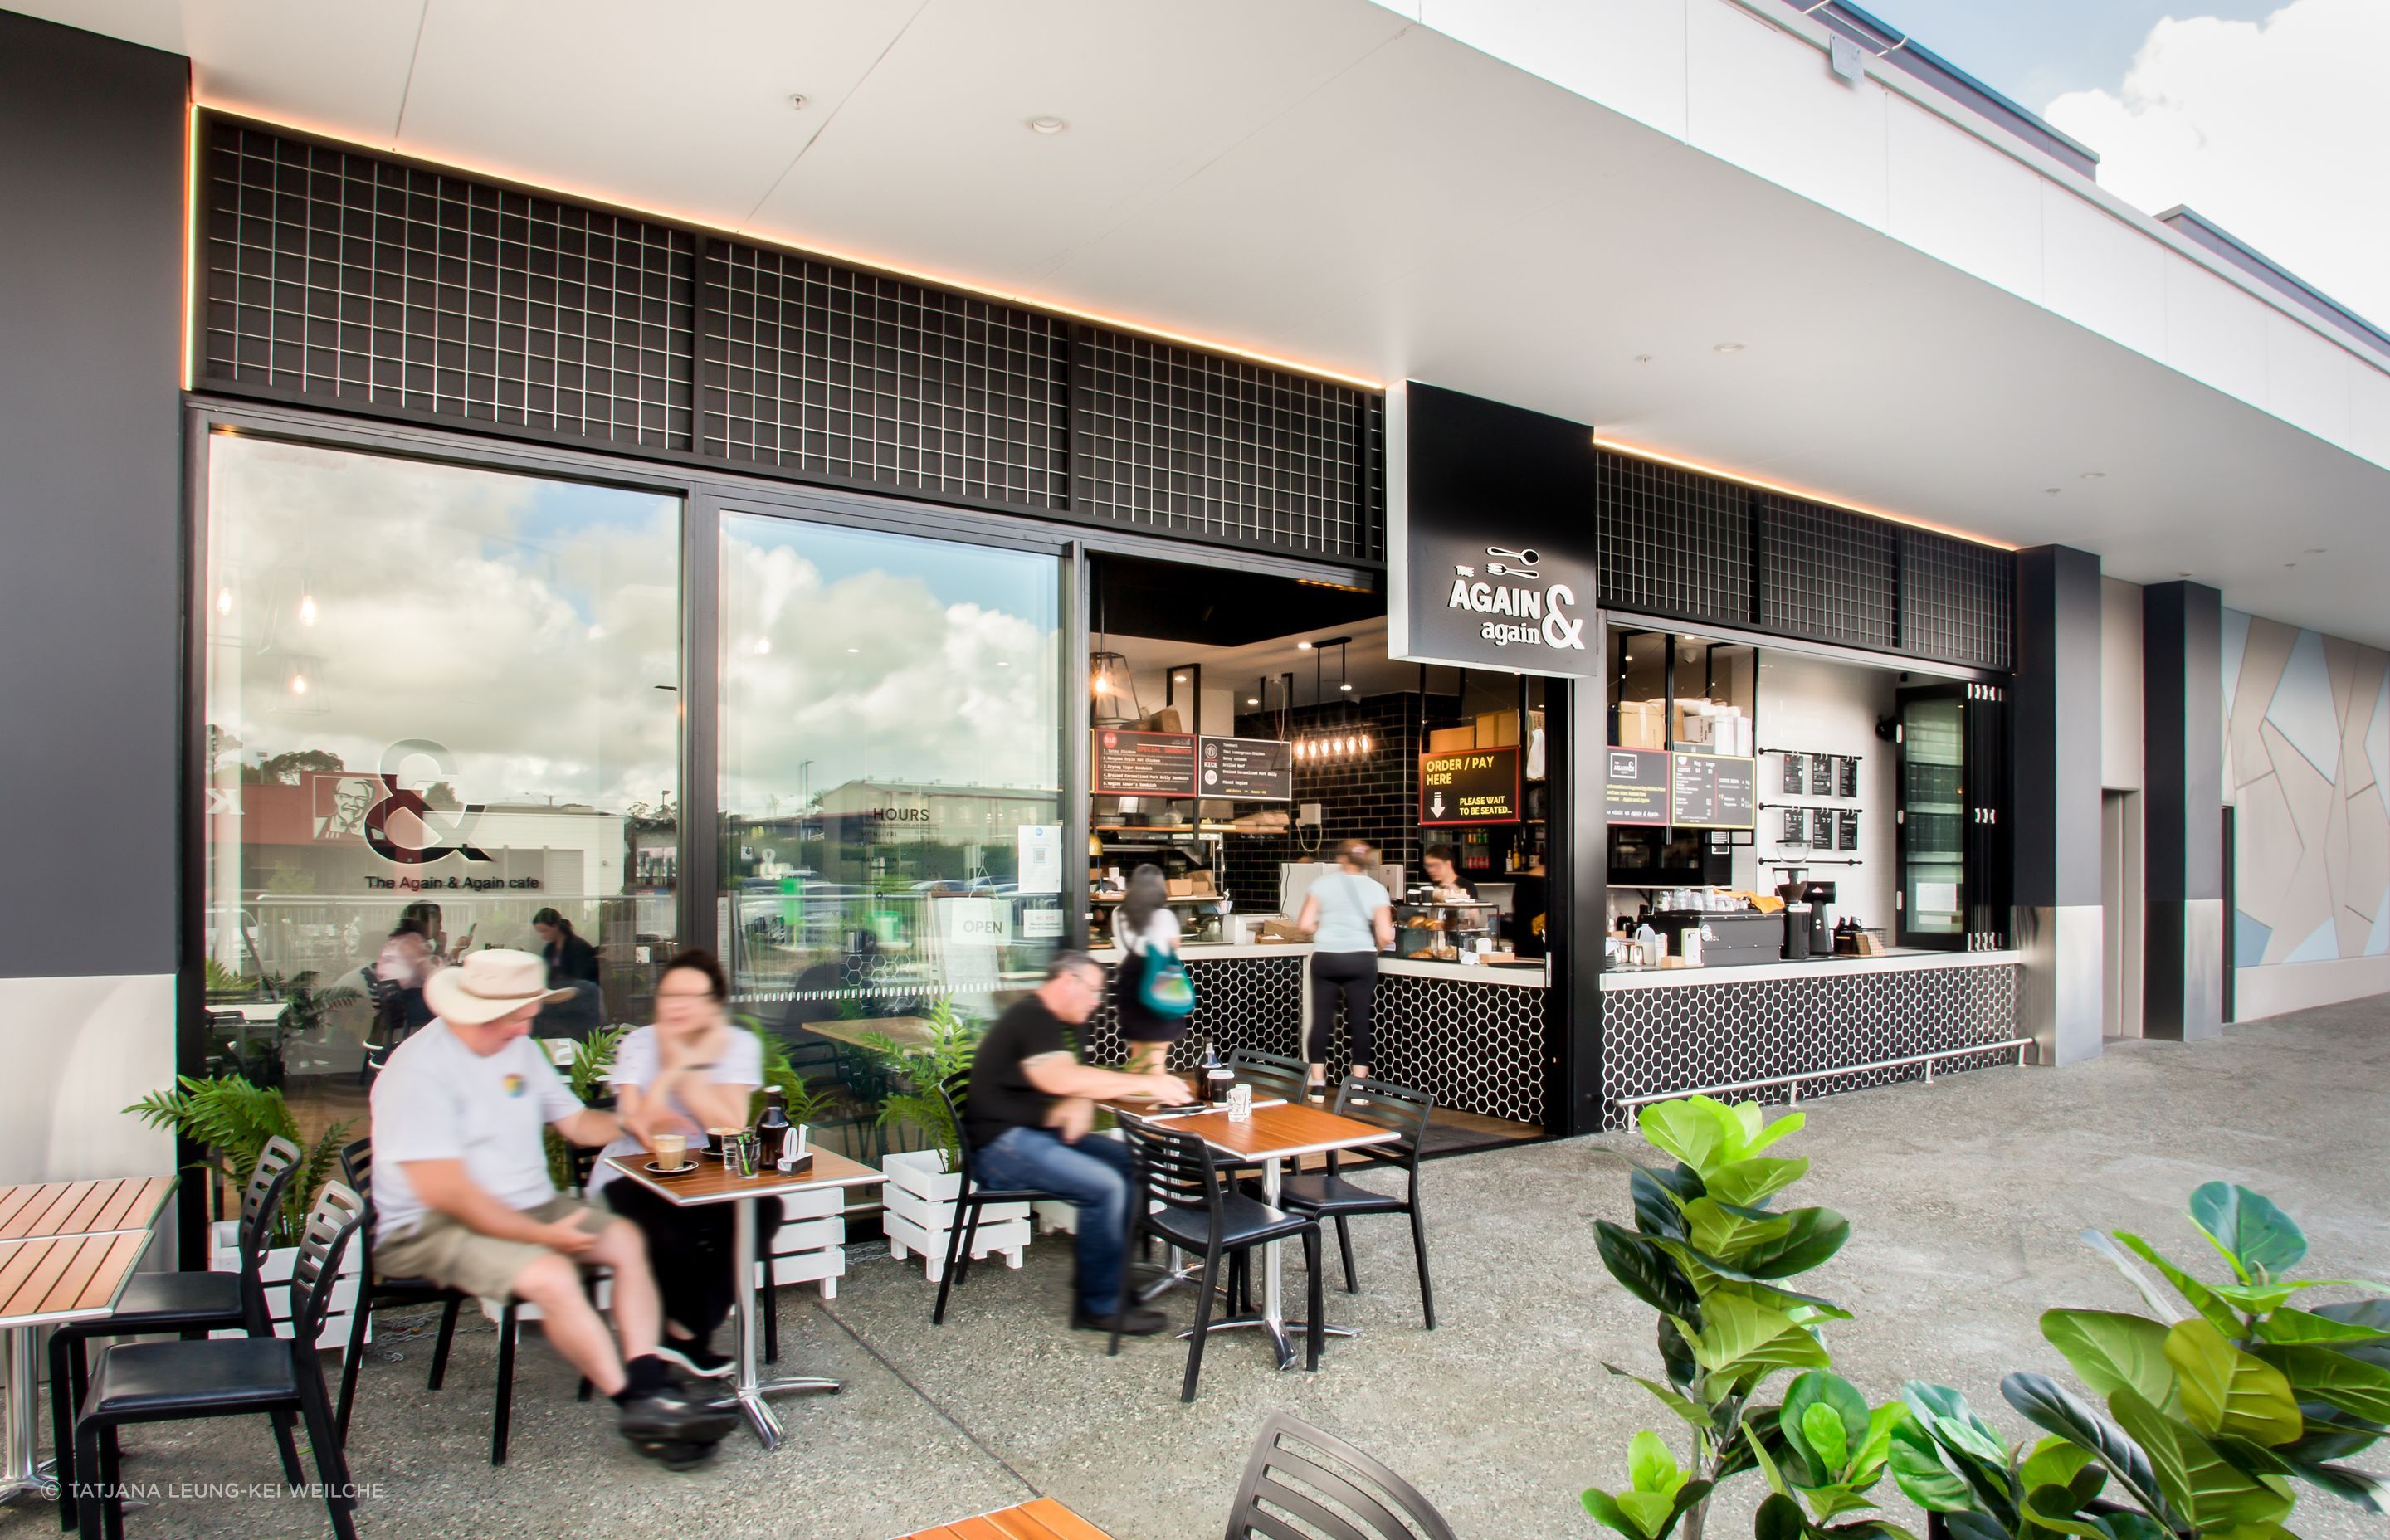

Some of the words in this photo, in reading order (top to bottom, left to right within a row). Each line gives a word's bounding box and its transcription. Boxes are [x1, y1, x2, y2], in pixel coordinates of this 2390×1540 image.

[1455, 565, 1474, 578] THE
[1449, 579, 1541, 620] AGAIN
[1542, 583, 1585, 650] &
[1481, 621, 1541, 646] again
[1427, 758, 1462, 772] ORDER
[1464, 757, 1470, 770] /
[1472, 756, 1494, 768] PAY
[1427, 773, 1452, 785] HERE
[363, 738, 494, 865] &
[1486, 796, 1505, 804] WAIT
[873, 808, 929, 821] HOURS
[365, 876, 395, 889] The
[400, 876, 443, 891] Again
[447, 876, 460, 889] &
[463, 876, 505, 891] Again
[509, 876, 539, 889] cafe
[963, 919, 1002, 934] OPEN
